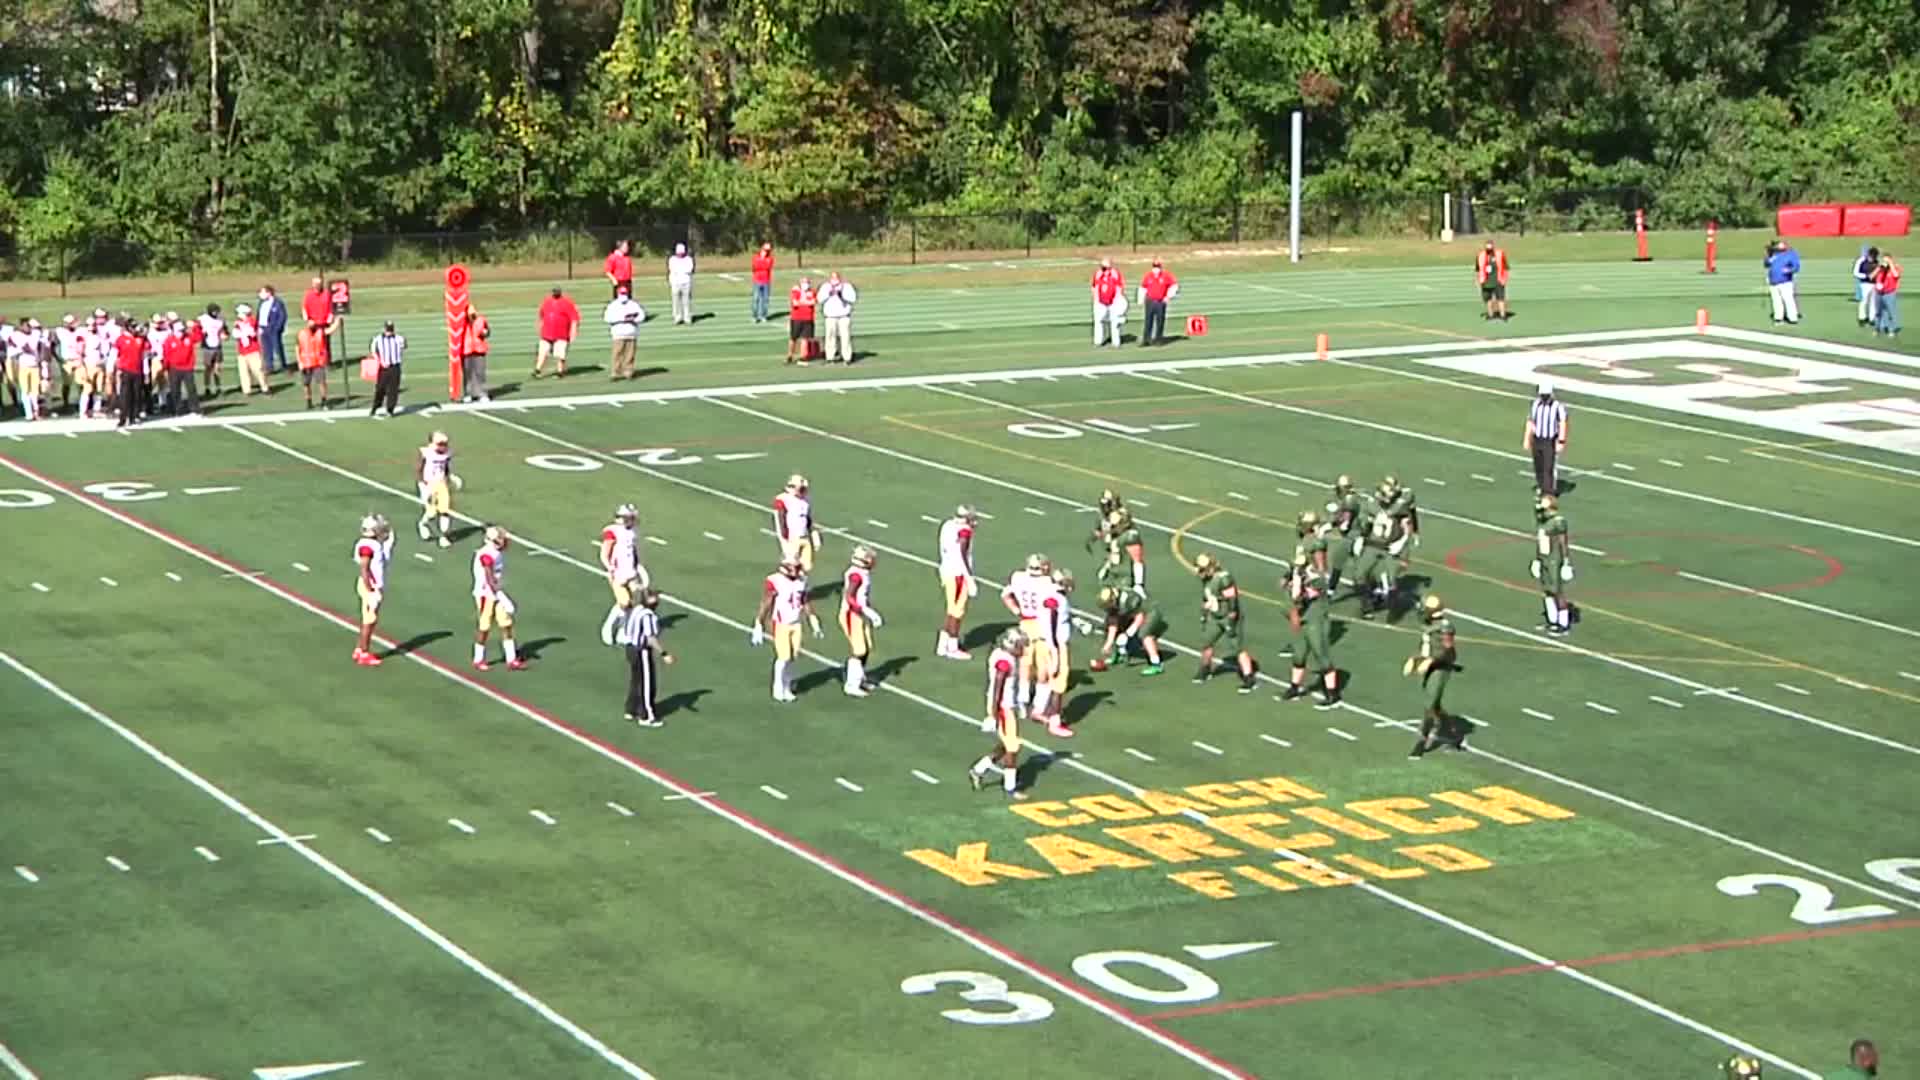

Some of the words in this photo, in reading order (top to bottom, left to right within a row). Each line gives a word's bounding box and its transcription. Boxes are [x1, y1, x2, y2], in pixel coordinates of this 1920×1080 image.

[1007, 420, 1151, 439] 10
[525, 448, 703, 471] 20
[1009, 777, 1326, 827] COACH
[904, 785, 1576, 886] KARCICH
[1167, 843, 1494, 899] FIELD
[901, 951, 1220, 1025] 30
